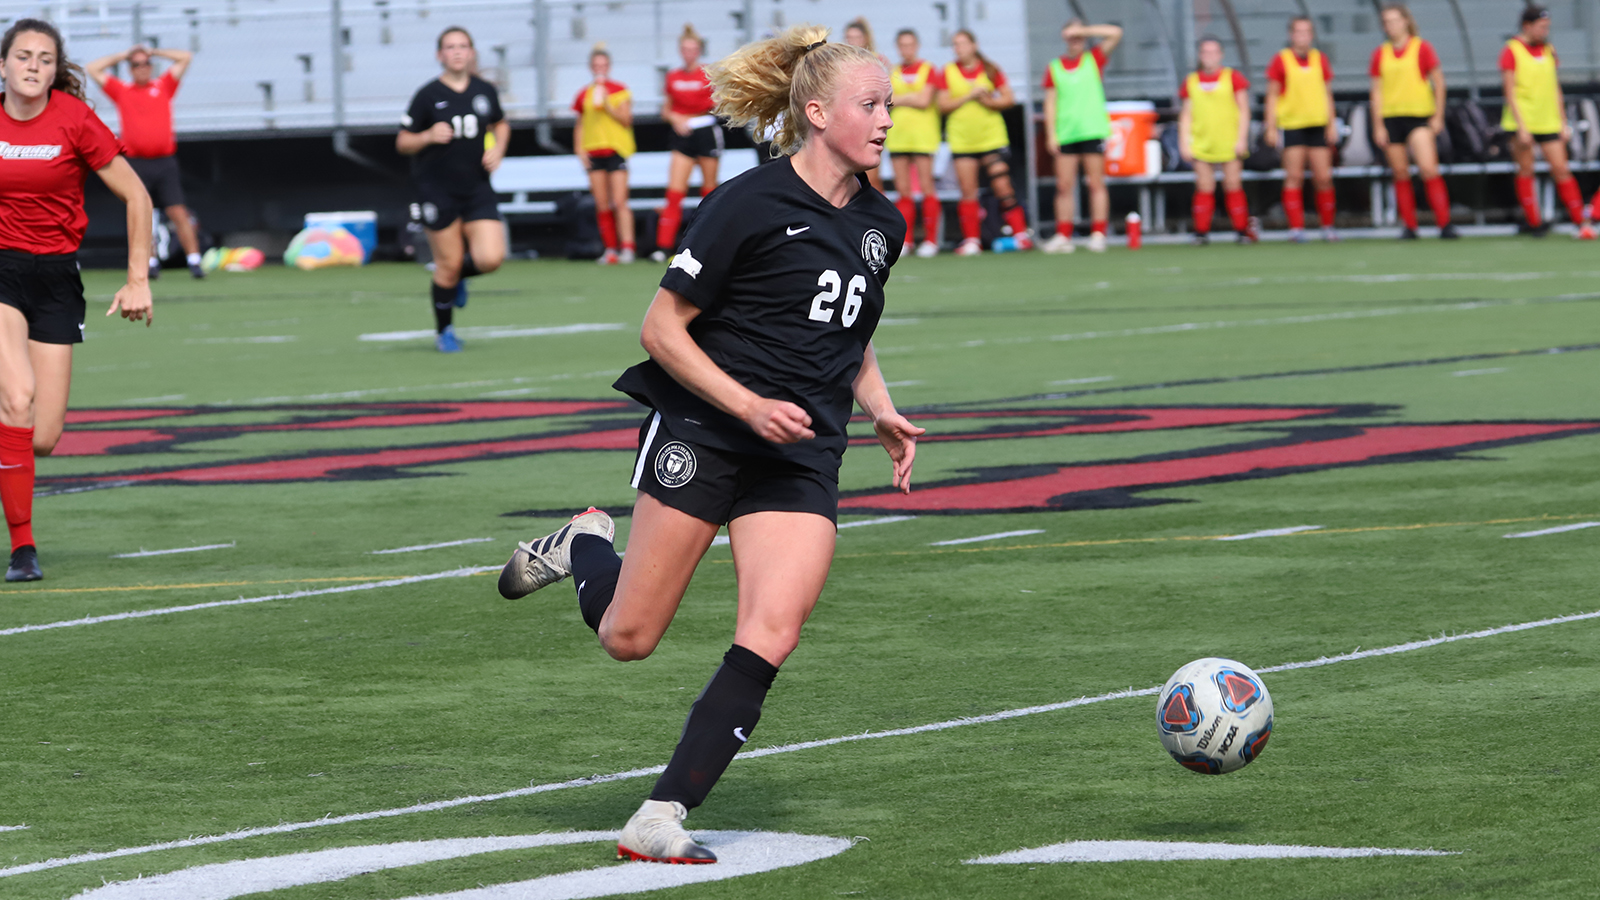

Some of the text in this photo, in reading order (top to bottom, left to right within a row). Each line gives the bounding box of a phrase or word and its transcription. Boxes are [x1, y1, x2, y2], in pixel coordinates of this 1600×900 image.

[451, 114, 479, 139] 18
[808, 269, 867, 328] 26
[1196, 715, 1223, 750] Wilson
[1218, 725, 1240, 756] NCAA
